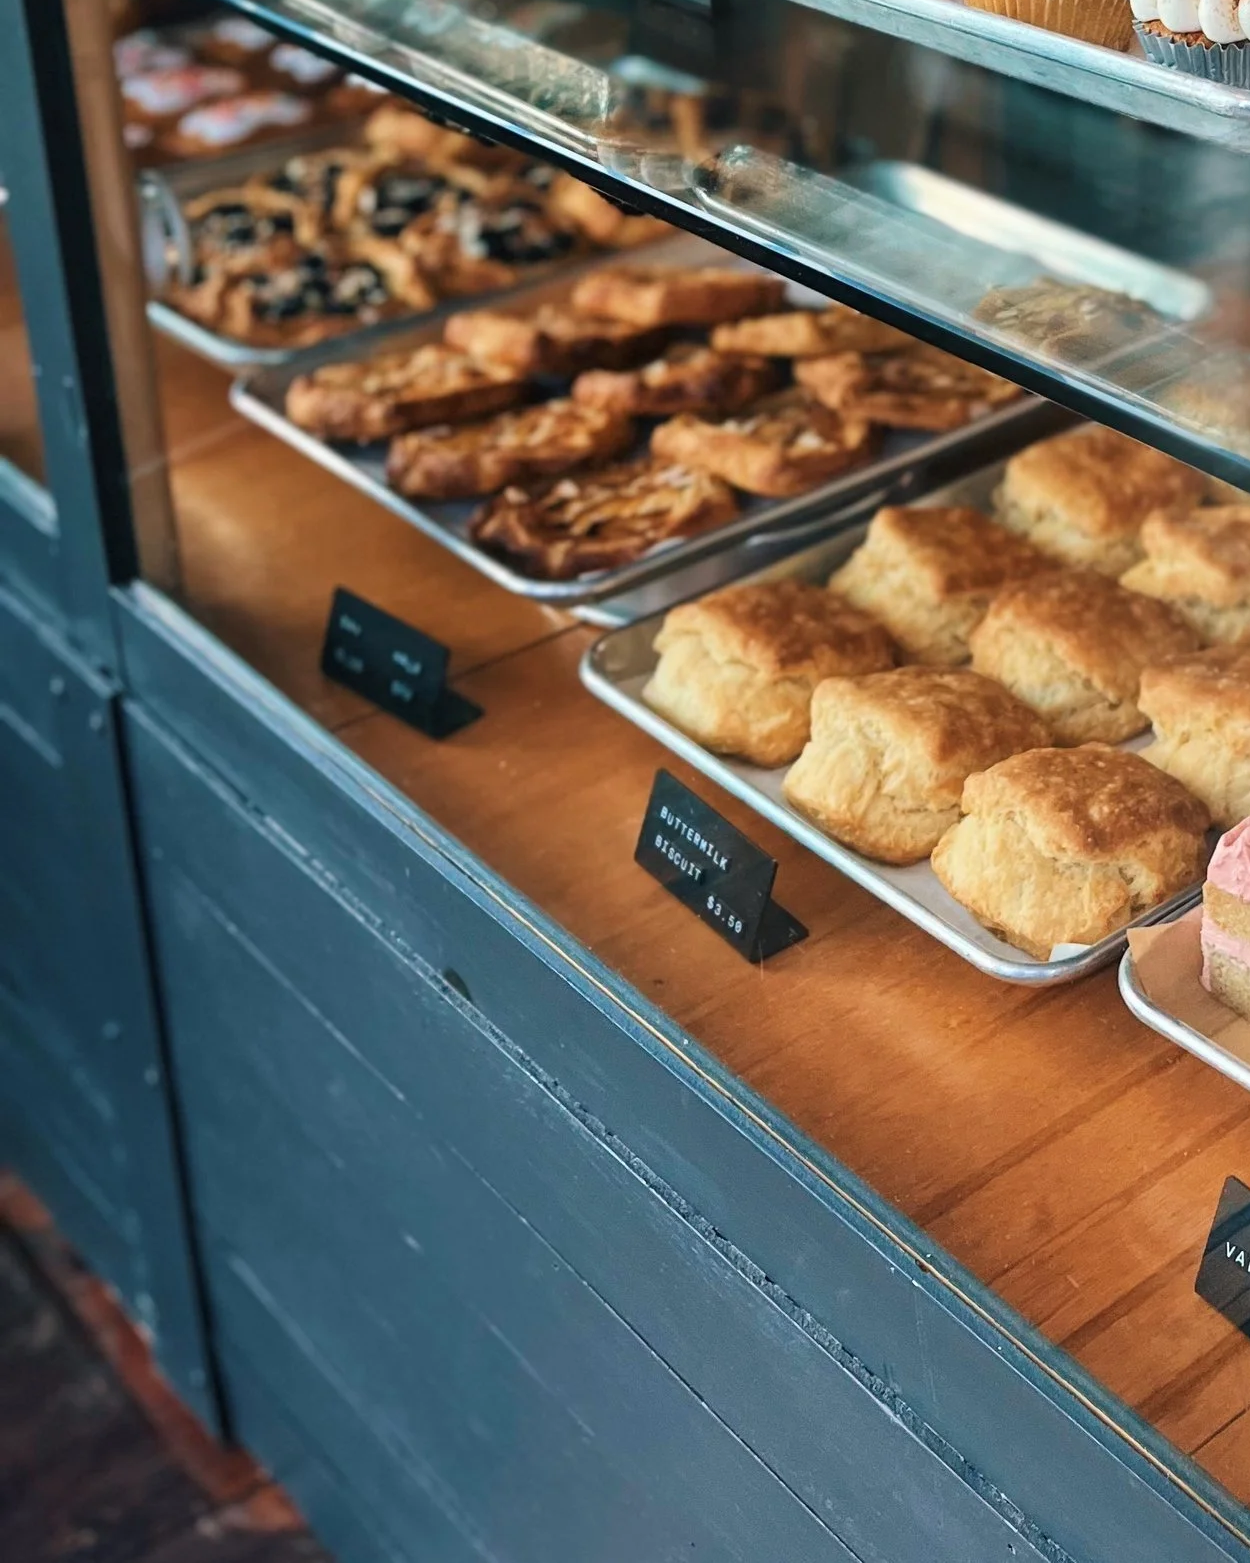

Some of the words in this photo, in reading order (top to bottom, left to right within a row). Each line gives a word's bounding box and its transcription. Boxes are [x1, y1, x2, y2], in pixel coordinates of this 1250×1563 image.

[655, 835, 701, 881] BISCUIT
[660, 806, 728, 871] BUTTERMILK
[707, 895, 743, 934] $3.50
